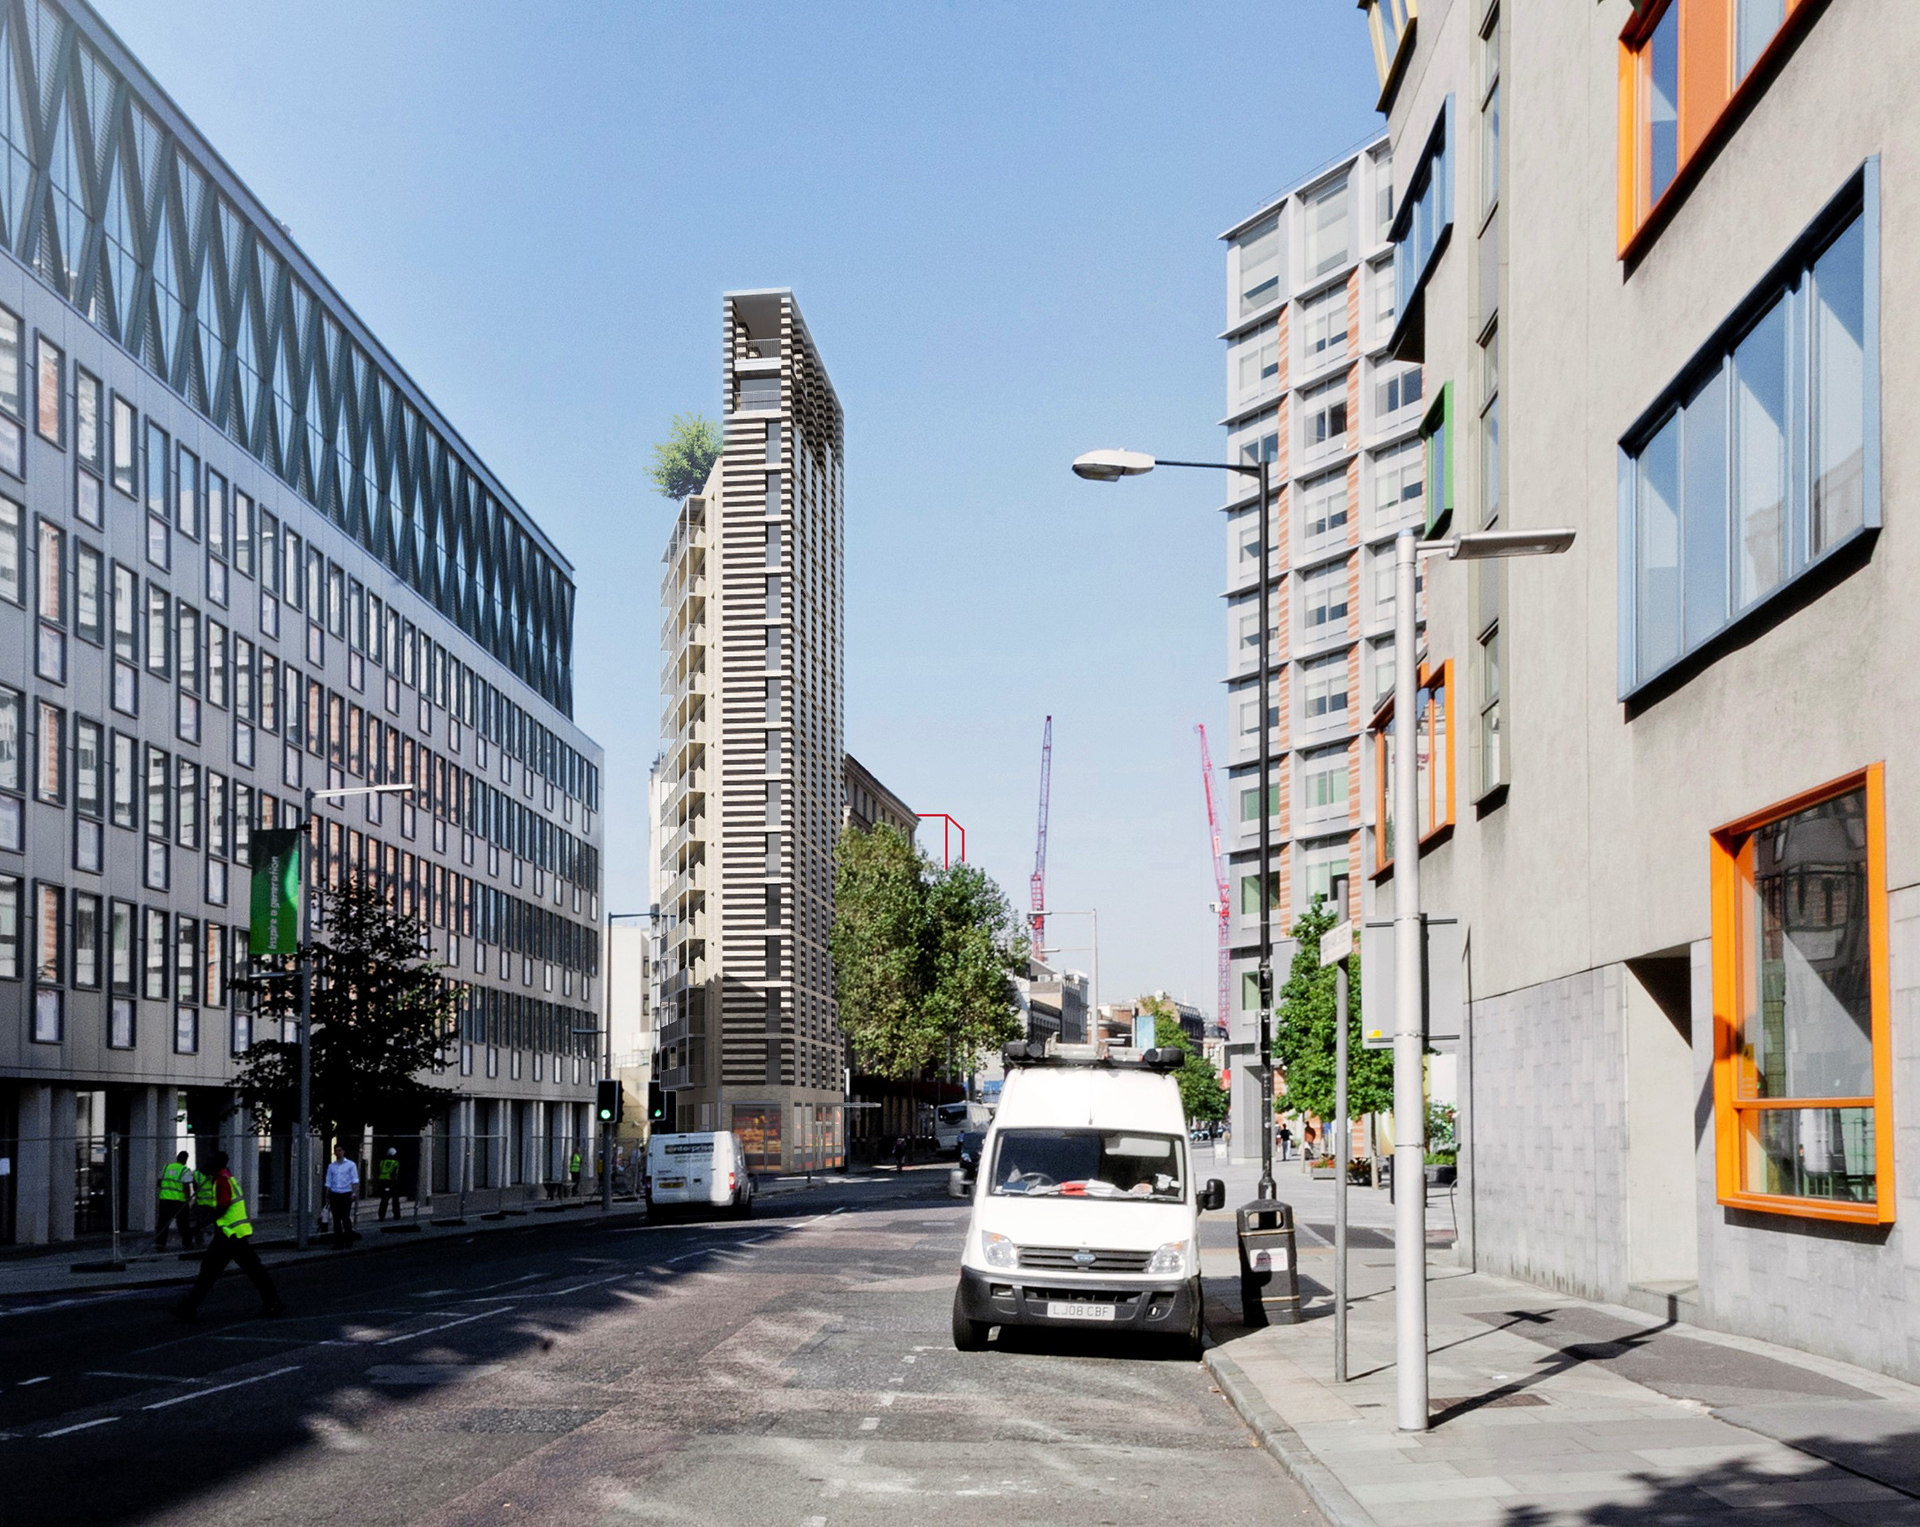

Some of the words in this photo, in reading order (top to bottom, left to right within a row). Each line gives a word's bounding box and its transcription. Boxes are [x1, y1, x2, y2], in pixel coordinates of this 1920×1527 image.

[269, 856, 281, 908] generation
[270, 909, 278, 917] a
[666, 1144, 714, 1153] enterprise
[1053, 1304, 1084, 1316] LJ08
[1087, 1306, 1110, 1317] CBF
